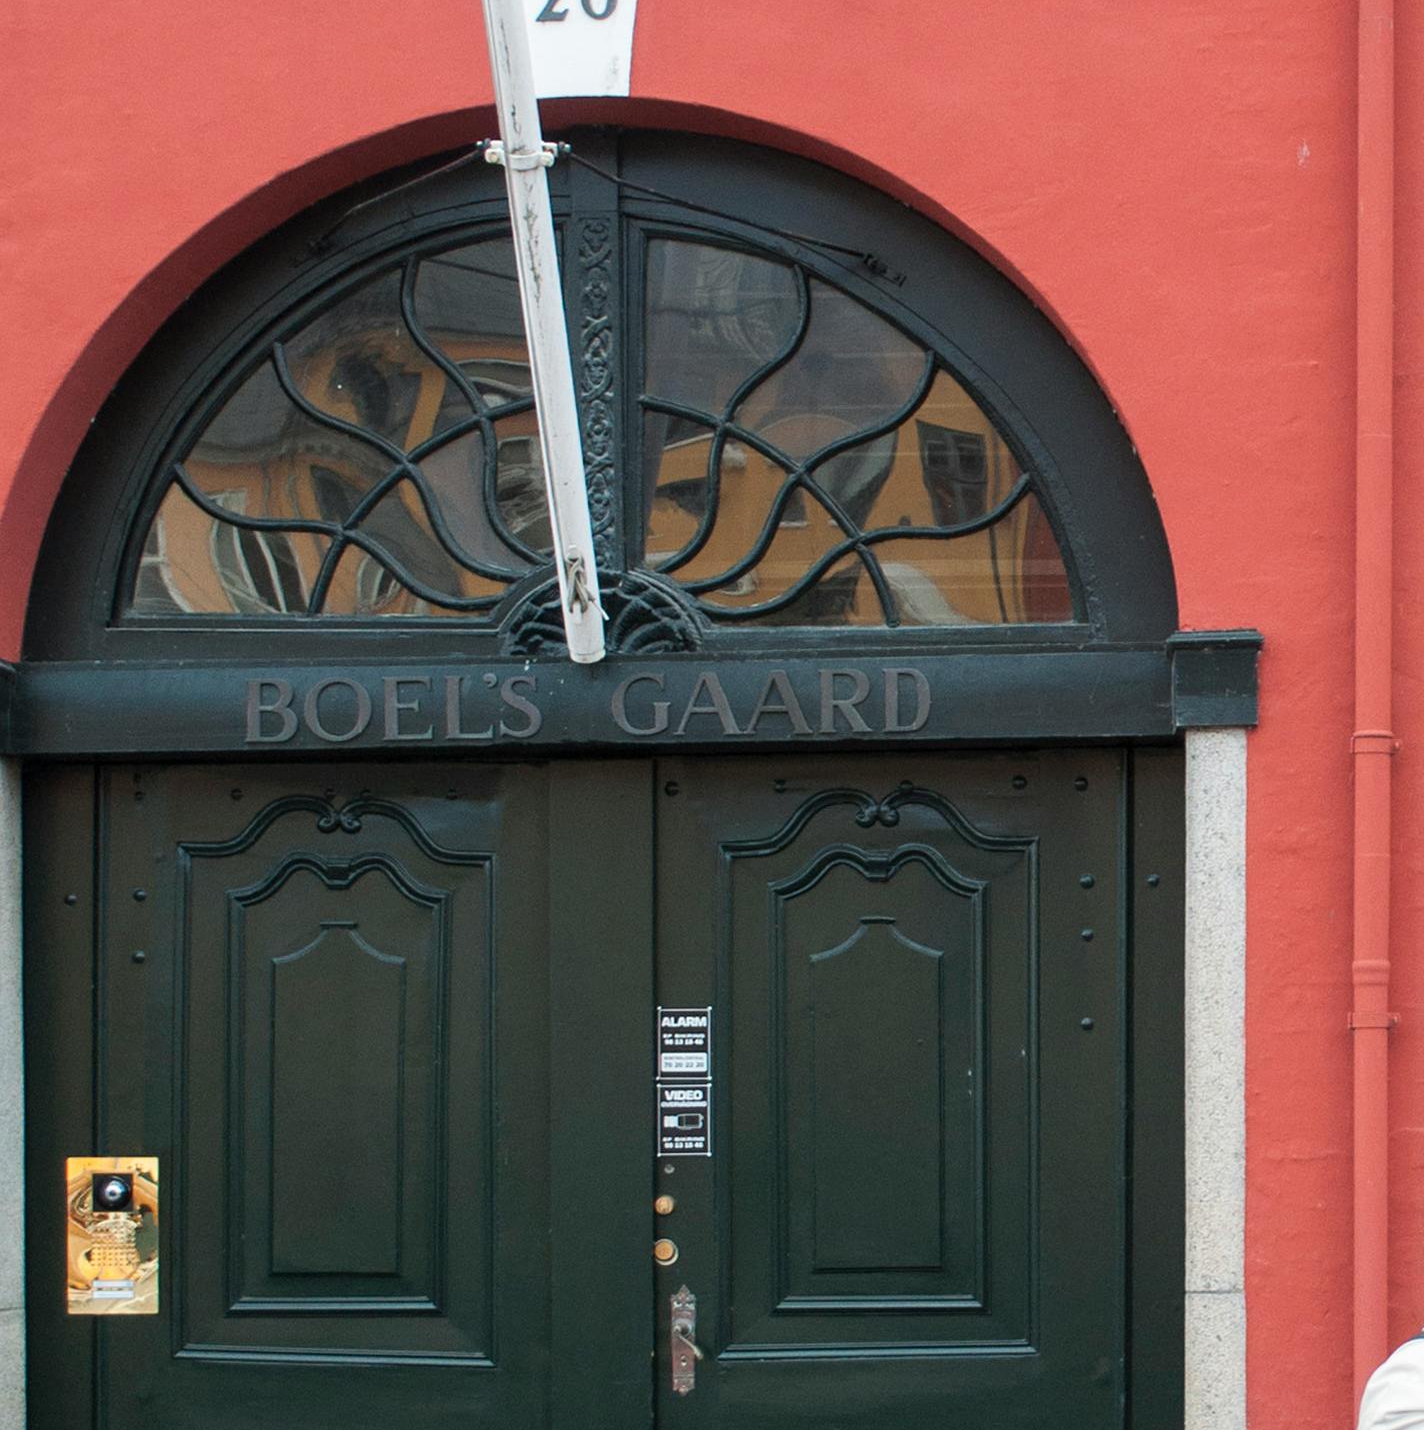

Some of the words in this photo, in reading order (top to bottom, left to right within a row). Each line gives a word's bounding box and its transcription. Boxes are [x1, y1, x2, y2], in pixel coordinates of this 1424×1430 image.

[244, 670, 543, 744] BOEL'S
[610, 666, 932, 737] GAARD
[661, 1016, 707, 1027] ALARM
[664, 1090, 703, 1101] VIDEO
